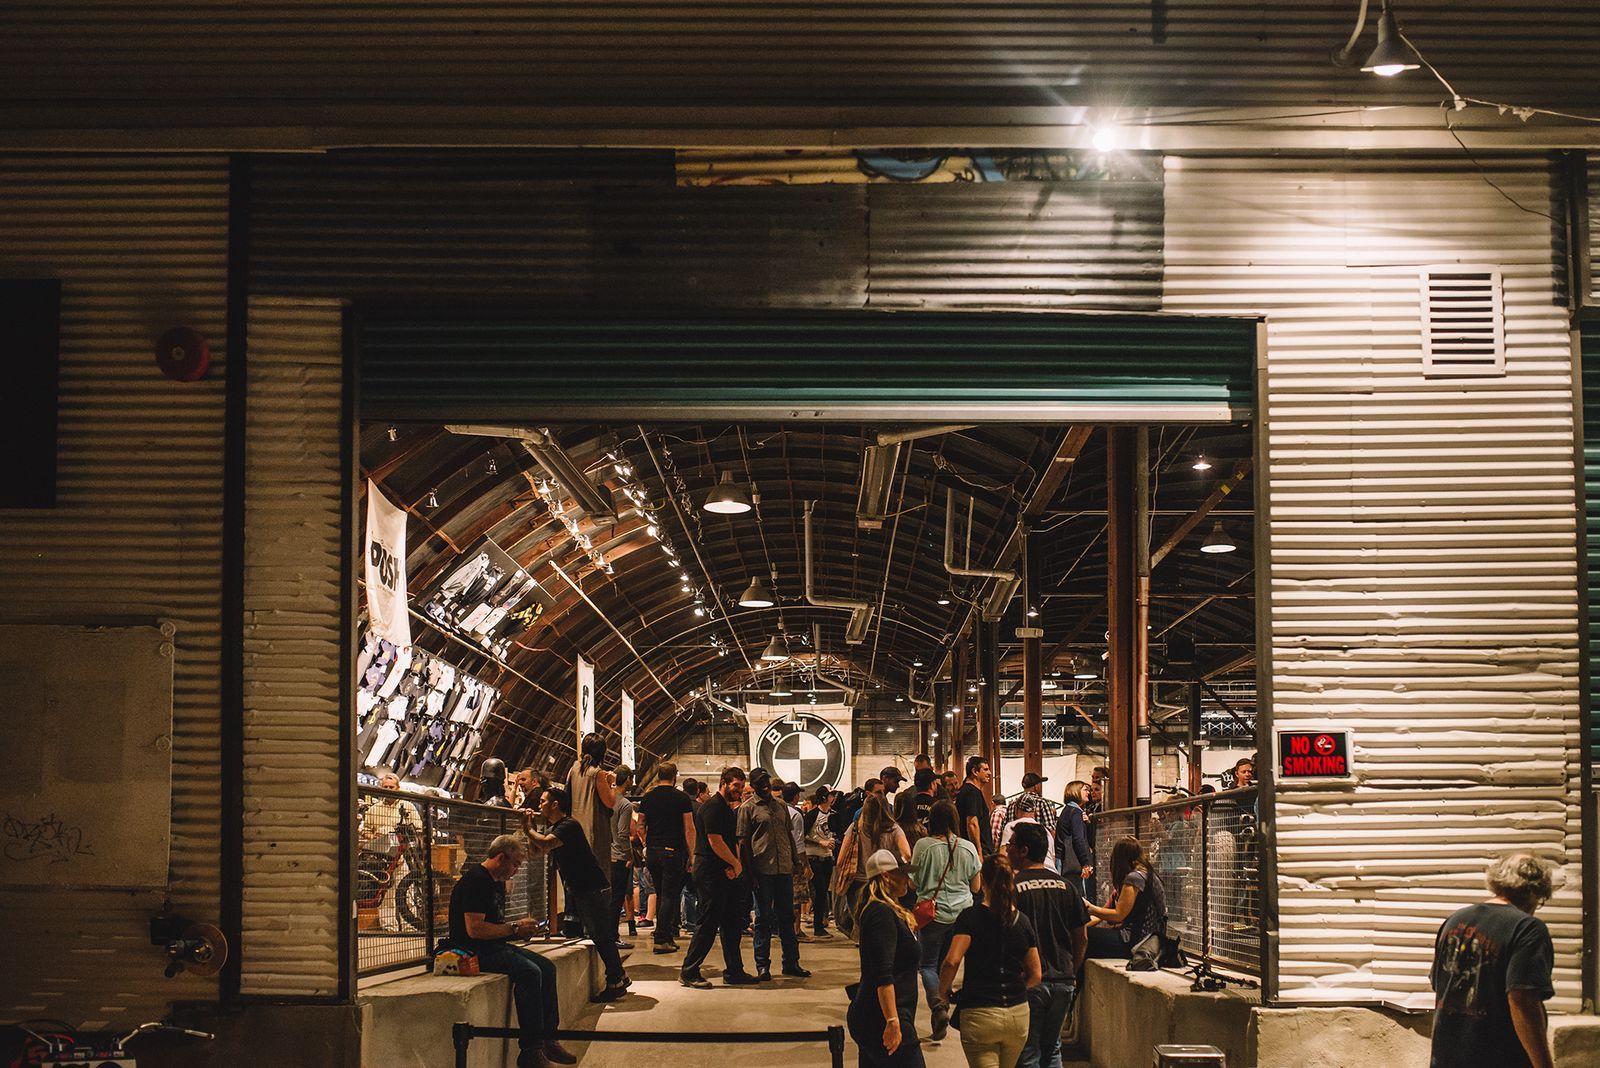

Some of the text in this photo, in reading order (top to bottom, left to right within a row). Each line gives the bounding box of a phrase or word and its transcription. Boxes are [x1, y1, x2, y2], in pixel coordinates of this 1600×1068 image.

[765, 718, 836, 745] BMW
[1291, 736, 1311, 755] NO
[1284, 755, 1345, 776] SMOKING
